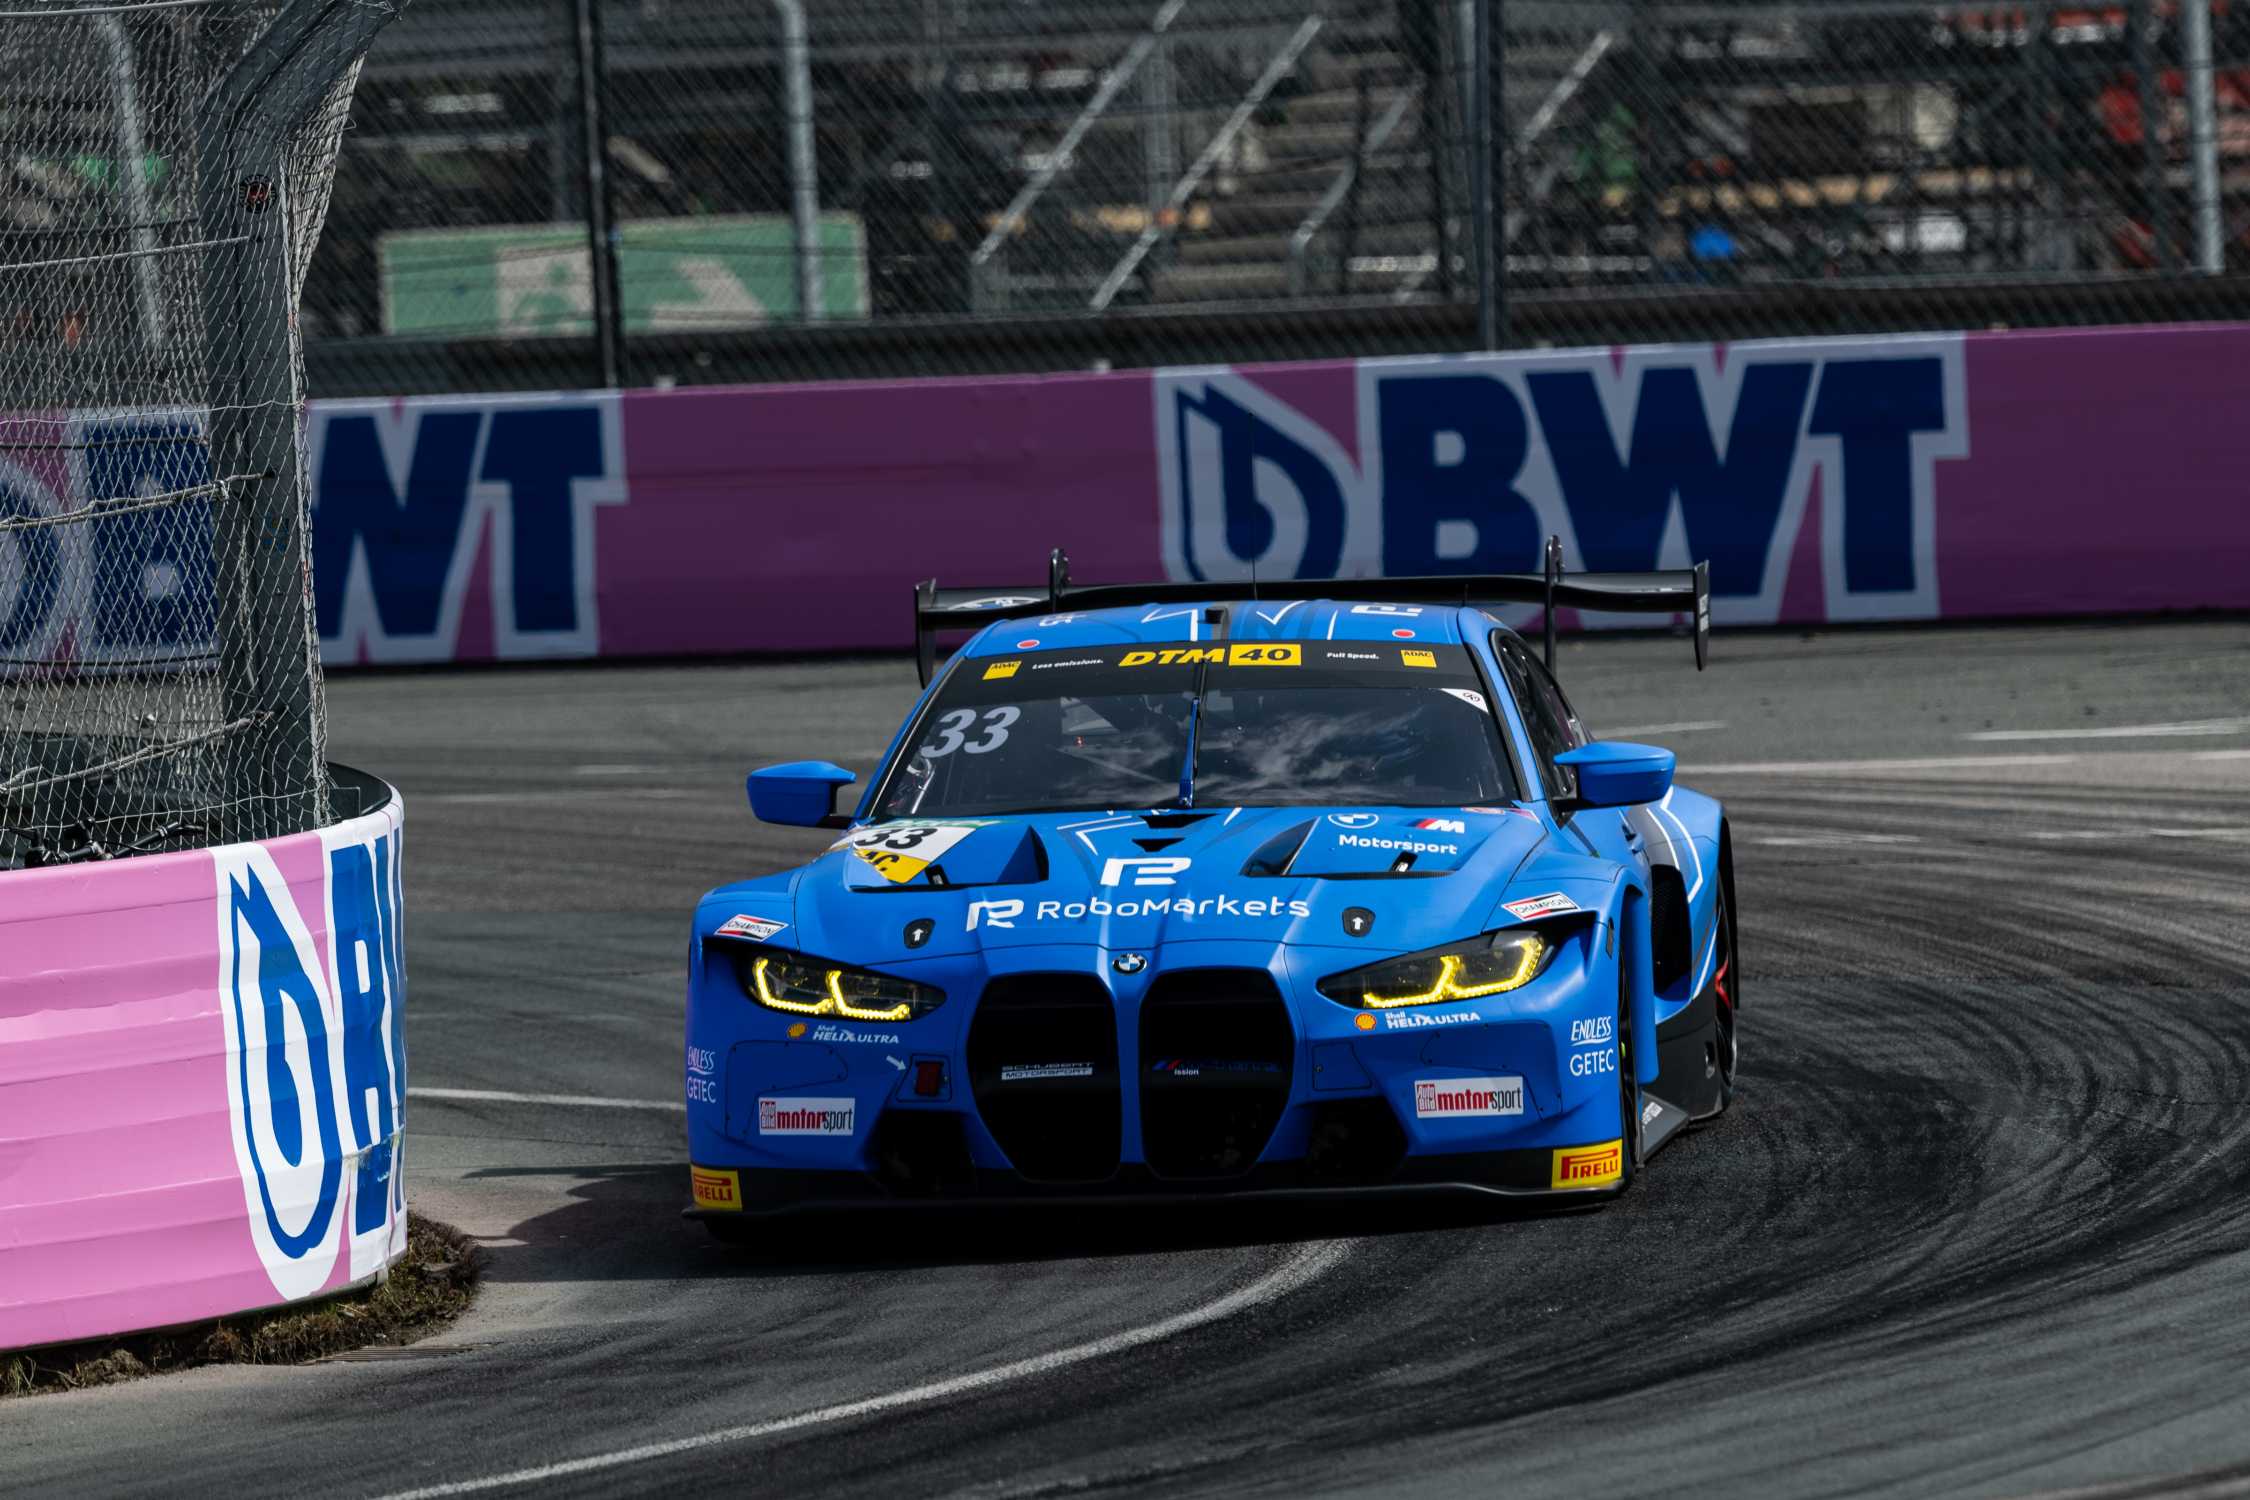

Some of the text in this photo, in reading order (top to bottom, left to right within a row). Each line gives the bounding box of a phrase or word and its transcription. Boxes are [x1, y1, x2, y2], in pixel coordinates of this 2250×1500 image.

[1377, 357, 1945, 597] BWT
[1118, 647, 1292, 668] DTM 40
[1326, 651, 1380, 661] Full Speed.
[1403, 650, 1434, 659] ADAC
[920, 705, 1021, 758] 33
[854, 827, 939, 850] 33
[1338, 834, 1458, 855] Motorsport
[1036, 894, 1312, 921] RoboMarkets
[1514, 896, 1571, 915] CHAMPION
[1385, 1011, 1406, 1021] Shell
[1386, 1012, 1481, 1030] HELIX ULTRA
[812, 1029, 900, 1045] HELIX ULTRA
[1570, 1016, 1612, 1042] ENDLESS
[687, 1046, 716, 1071] ENDLESS
[1569, 1048, 1615, 1077] GETEC
[686, 1076, 717, 1104] GETEC
[1437, 1087, 1522, 1112] motorsport
[776, 1108, 853, 1133] motorsport
[1560, 1147, 1619, 1180] PIRELLI
